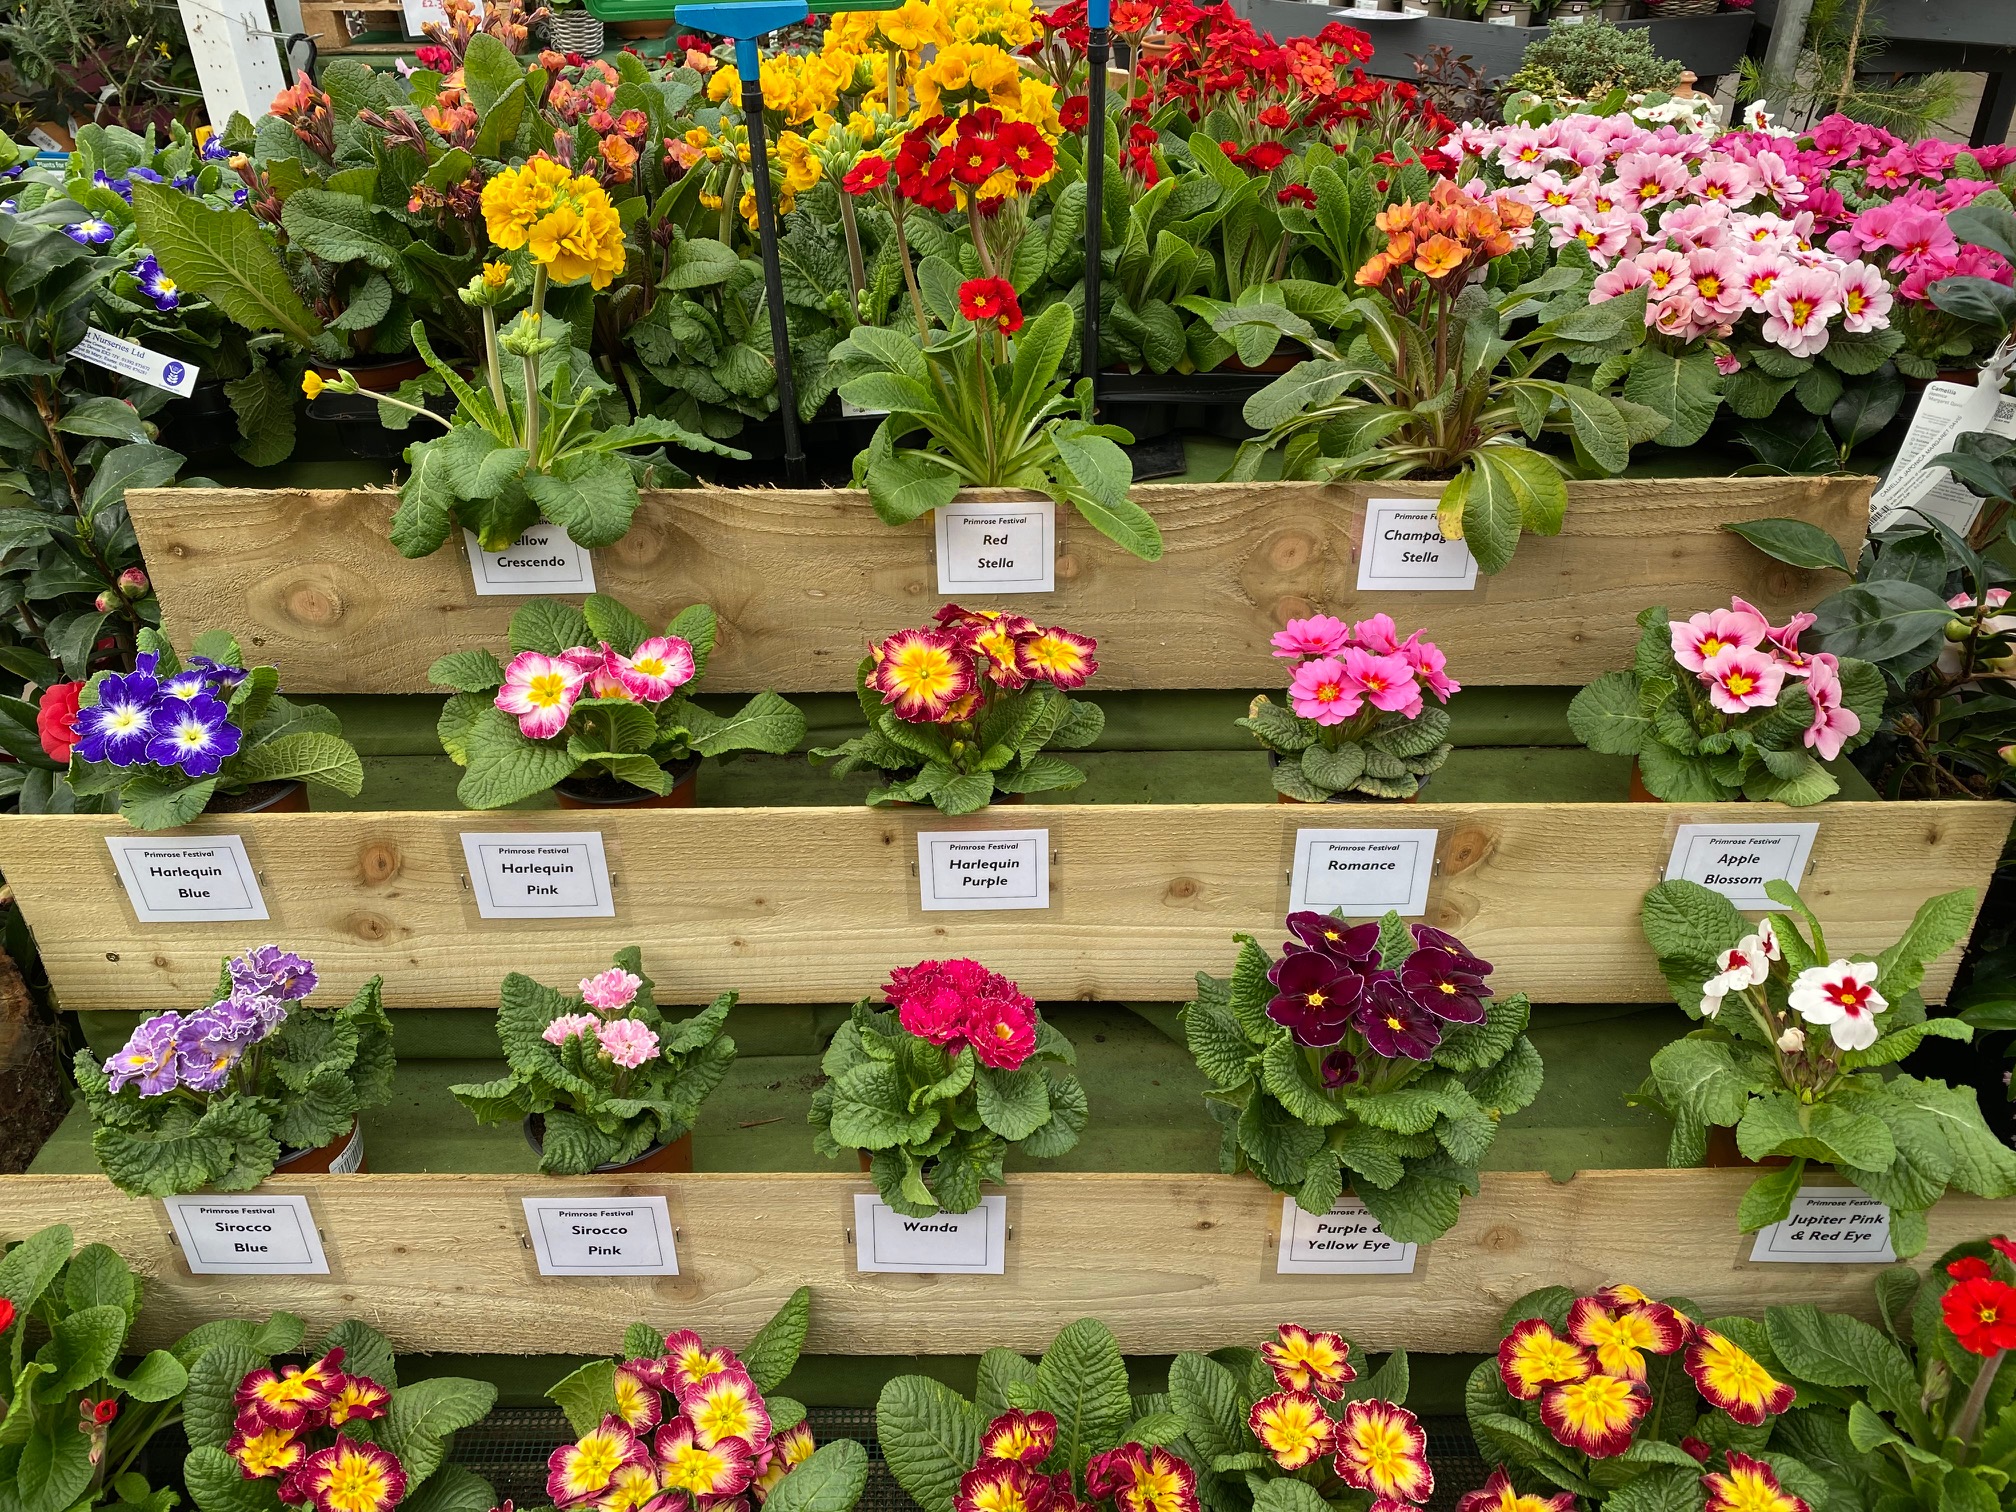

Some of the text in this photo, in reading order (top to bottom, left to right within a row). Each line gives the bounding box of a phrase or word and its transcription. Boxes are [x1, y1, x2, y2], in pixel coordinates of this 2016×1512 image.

[92, 333, 130, 353] Nurseries
[131, 347, 146, 359] Ltd
[1931, 385, 1956, 396] Camellia
[1880, 476, 1903, 497] CAMELLIA
[1904, 454, 1925, 478] JAPONICA
[1925, 429, 1949, 455] MARGARET
[1949, 415, 1963, 430] DAVIS
[513, 535, 549, 545] ellow
[983, 534, 1008, 545] Red
[497, 556, 565, 567] Crescendo
[1402, 552, 1439, 562] Stella
[978, 558, 1014, 568] Stella
[949, 859, 1019, 871] Harlequin
[1328, 860, 1396, 870] Romance
[1717, 854, 1760, 866] Apple
[150, 867, 222, 879] Harlequin
[502, 863, 574, 876] Harlequin
[962, 876, 1008, 888] Purple
[1704, 874, 1762, 884] Blossom
[178, 888, 211, 898] Blue
[527, 885, 559, 895] Pink
[1789, 1214, 1884, 1226] Jupiter Pink
[215, 1222, 272, 1232] Sirocco
[572, 1225, 628, 1235] Sirocco
[904, 1222, 958, 1232] Wanda
[1317, 1224, 1367, 1236] Purple
[1791, 1231, 1872, 1243] & Red Eye
[234, 1243, 268, 1252] Blue
[588, 1246, 622, 1255] Pink
[1309, 1240, 1390, 1252] Yellow Eye
